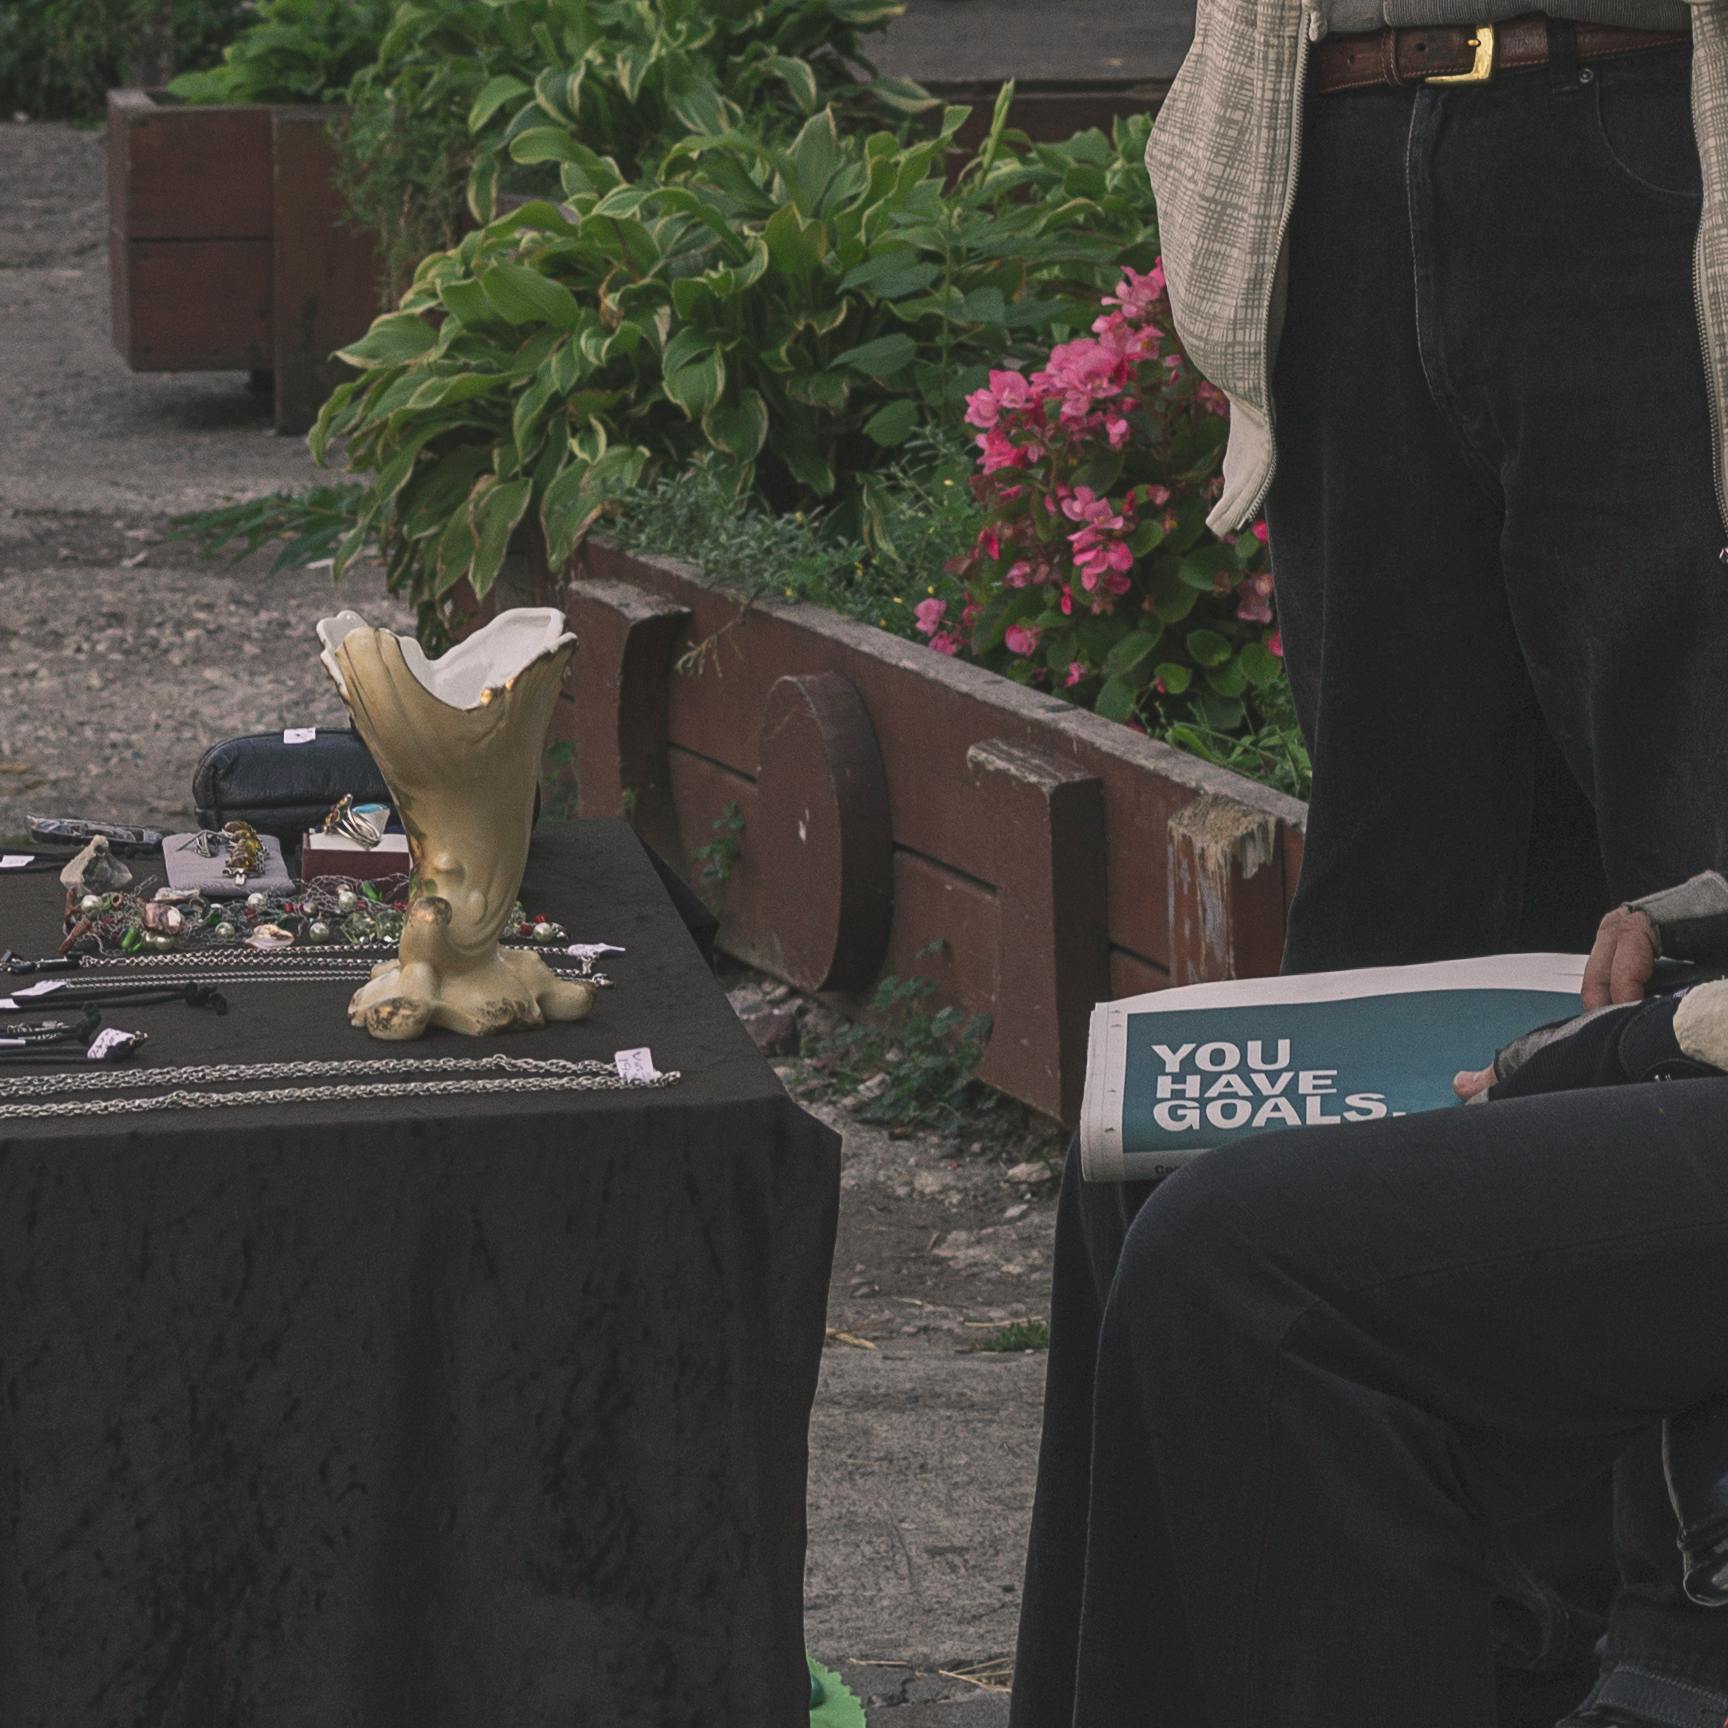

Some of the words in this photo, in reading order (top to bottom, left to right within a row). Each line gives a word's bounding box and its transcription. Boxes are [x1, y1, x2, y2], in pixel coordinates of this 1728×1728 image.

[1151, 1038, 1291, 1073] YOU
[1156, 1070, 1338, 1098] HAVE
[1152, 1091, 1407, 1131] GOALS.
